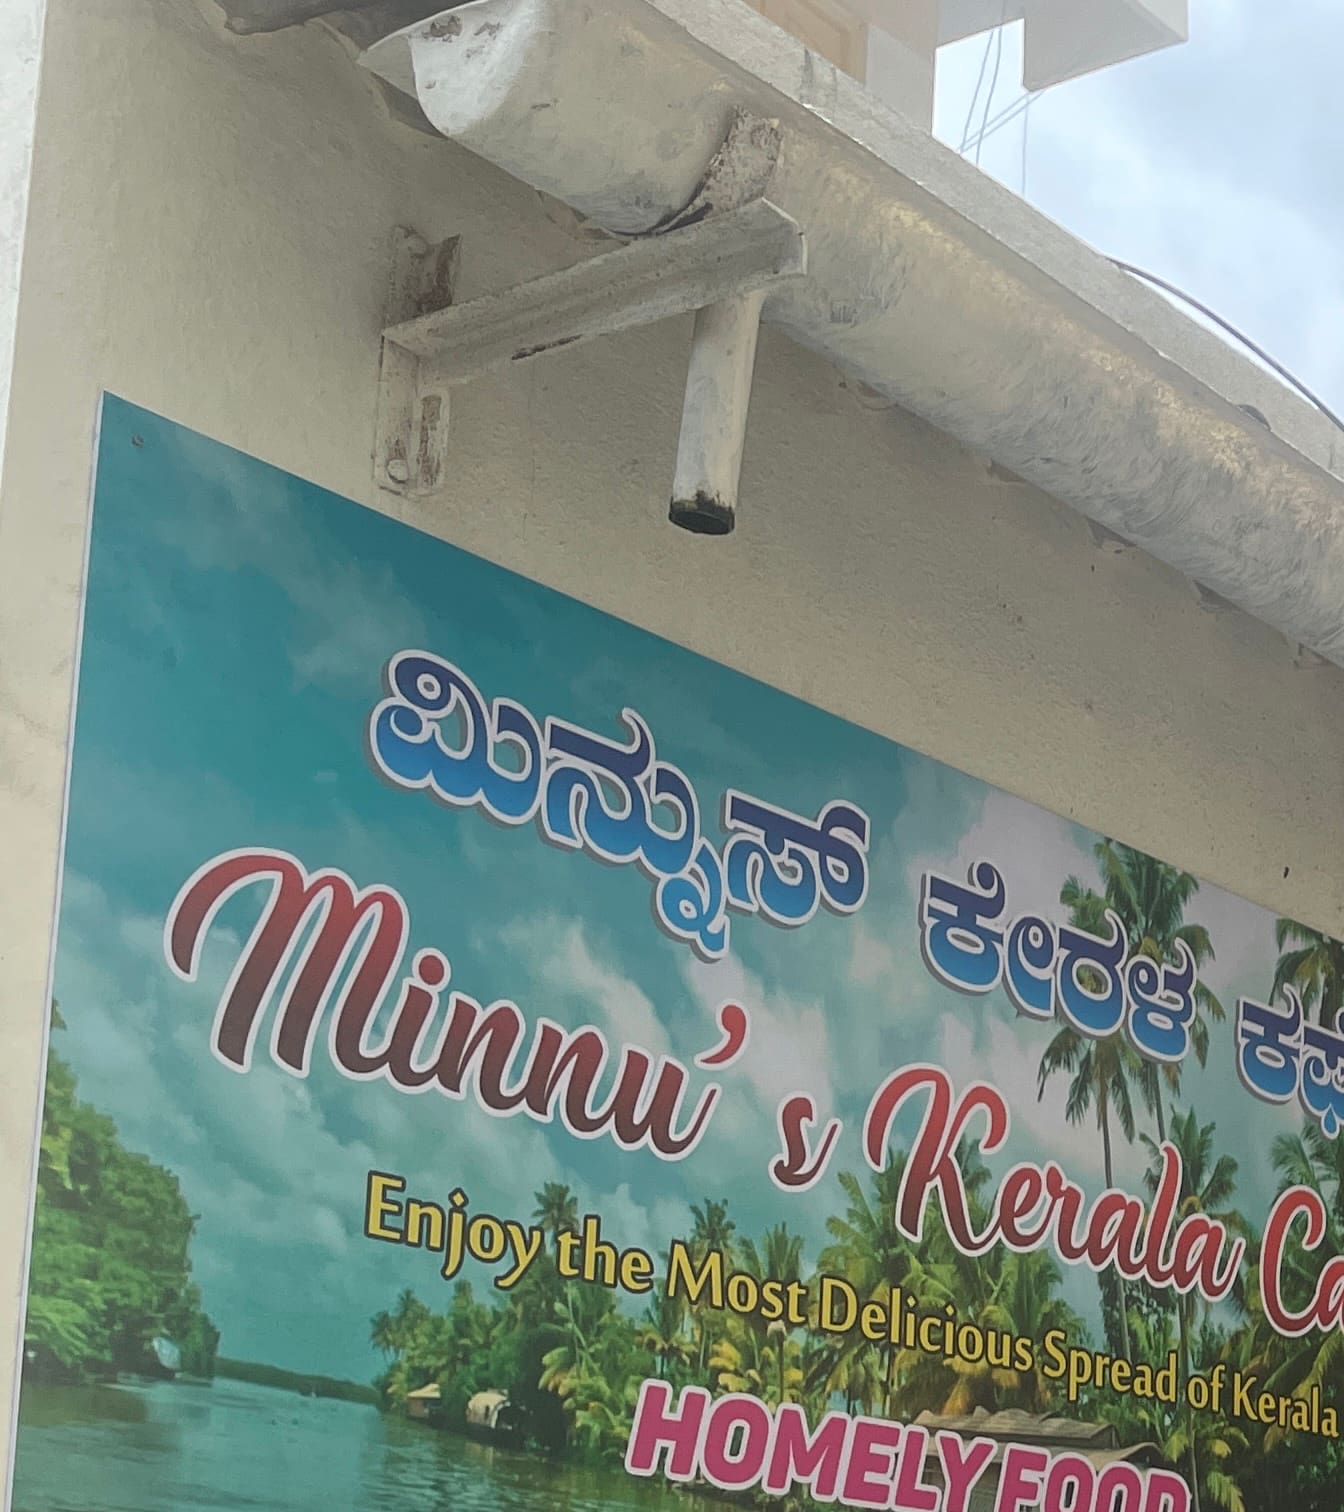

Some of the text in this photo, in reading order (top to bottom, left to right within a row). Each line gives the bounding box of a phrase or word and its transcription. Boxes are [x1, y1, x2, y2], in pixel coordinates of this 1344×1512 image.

[922, 861, 1197, 1063] ಕೇರಳ
[864, 1062, 1245, 1301] Kerala
[366, 1171, 1339, 1439] Enjoy the Most Delicious Spread of Kerala
